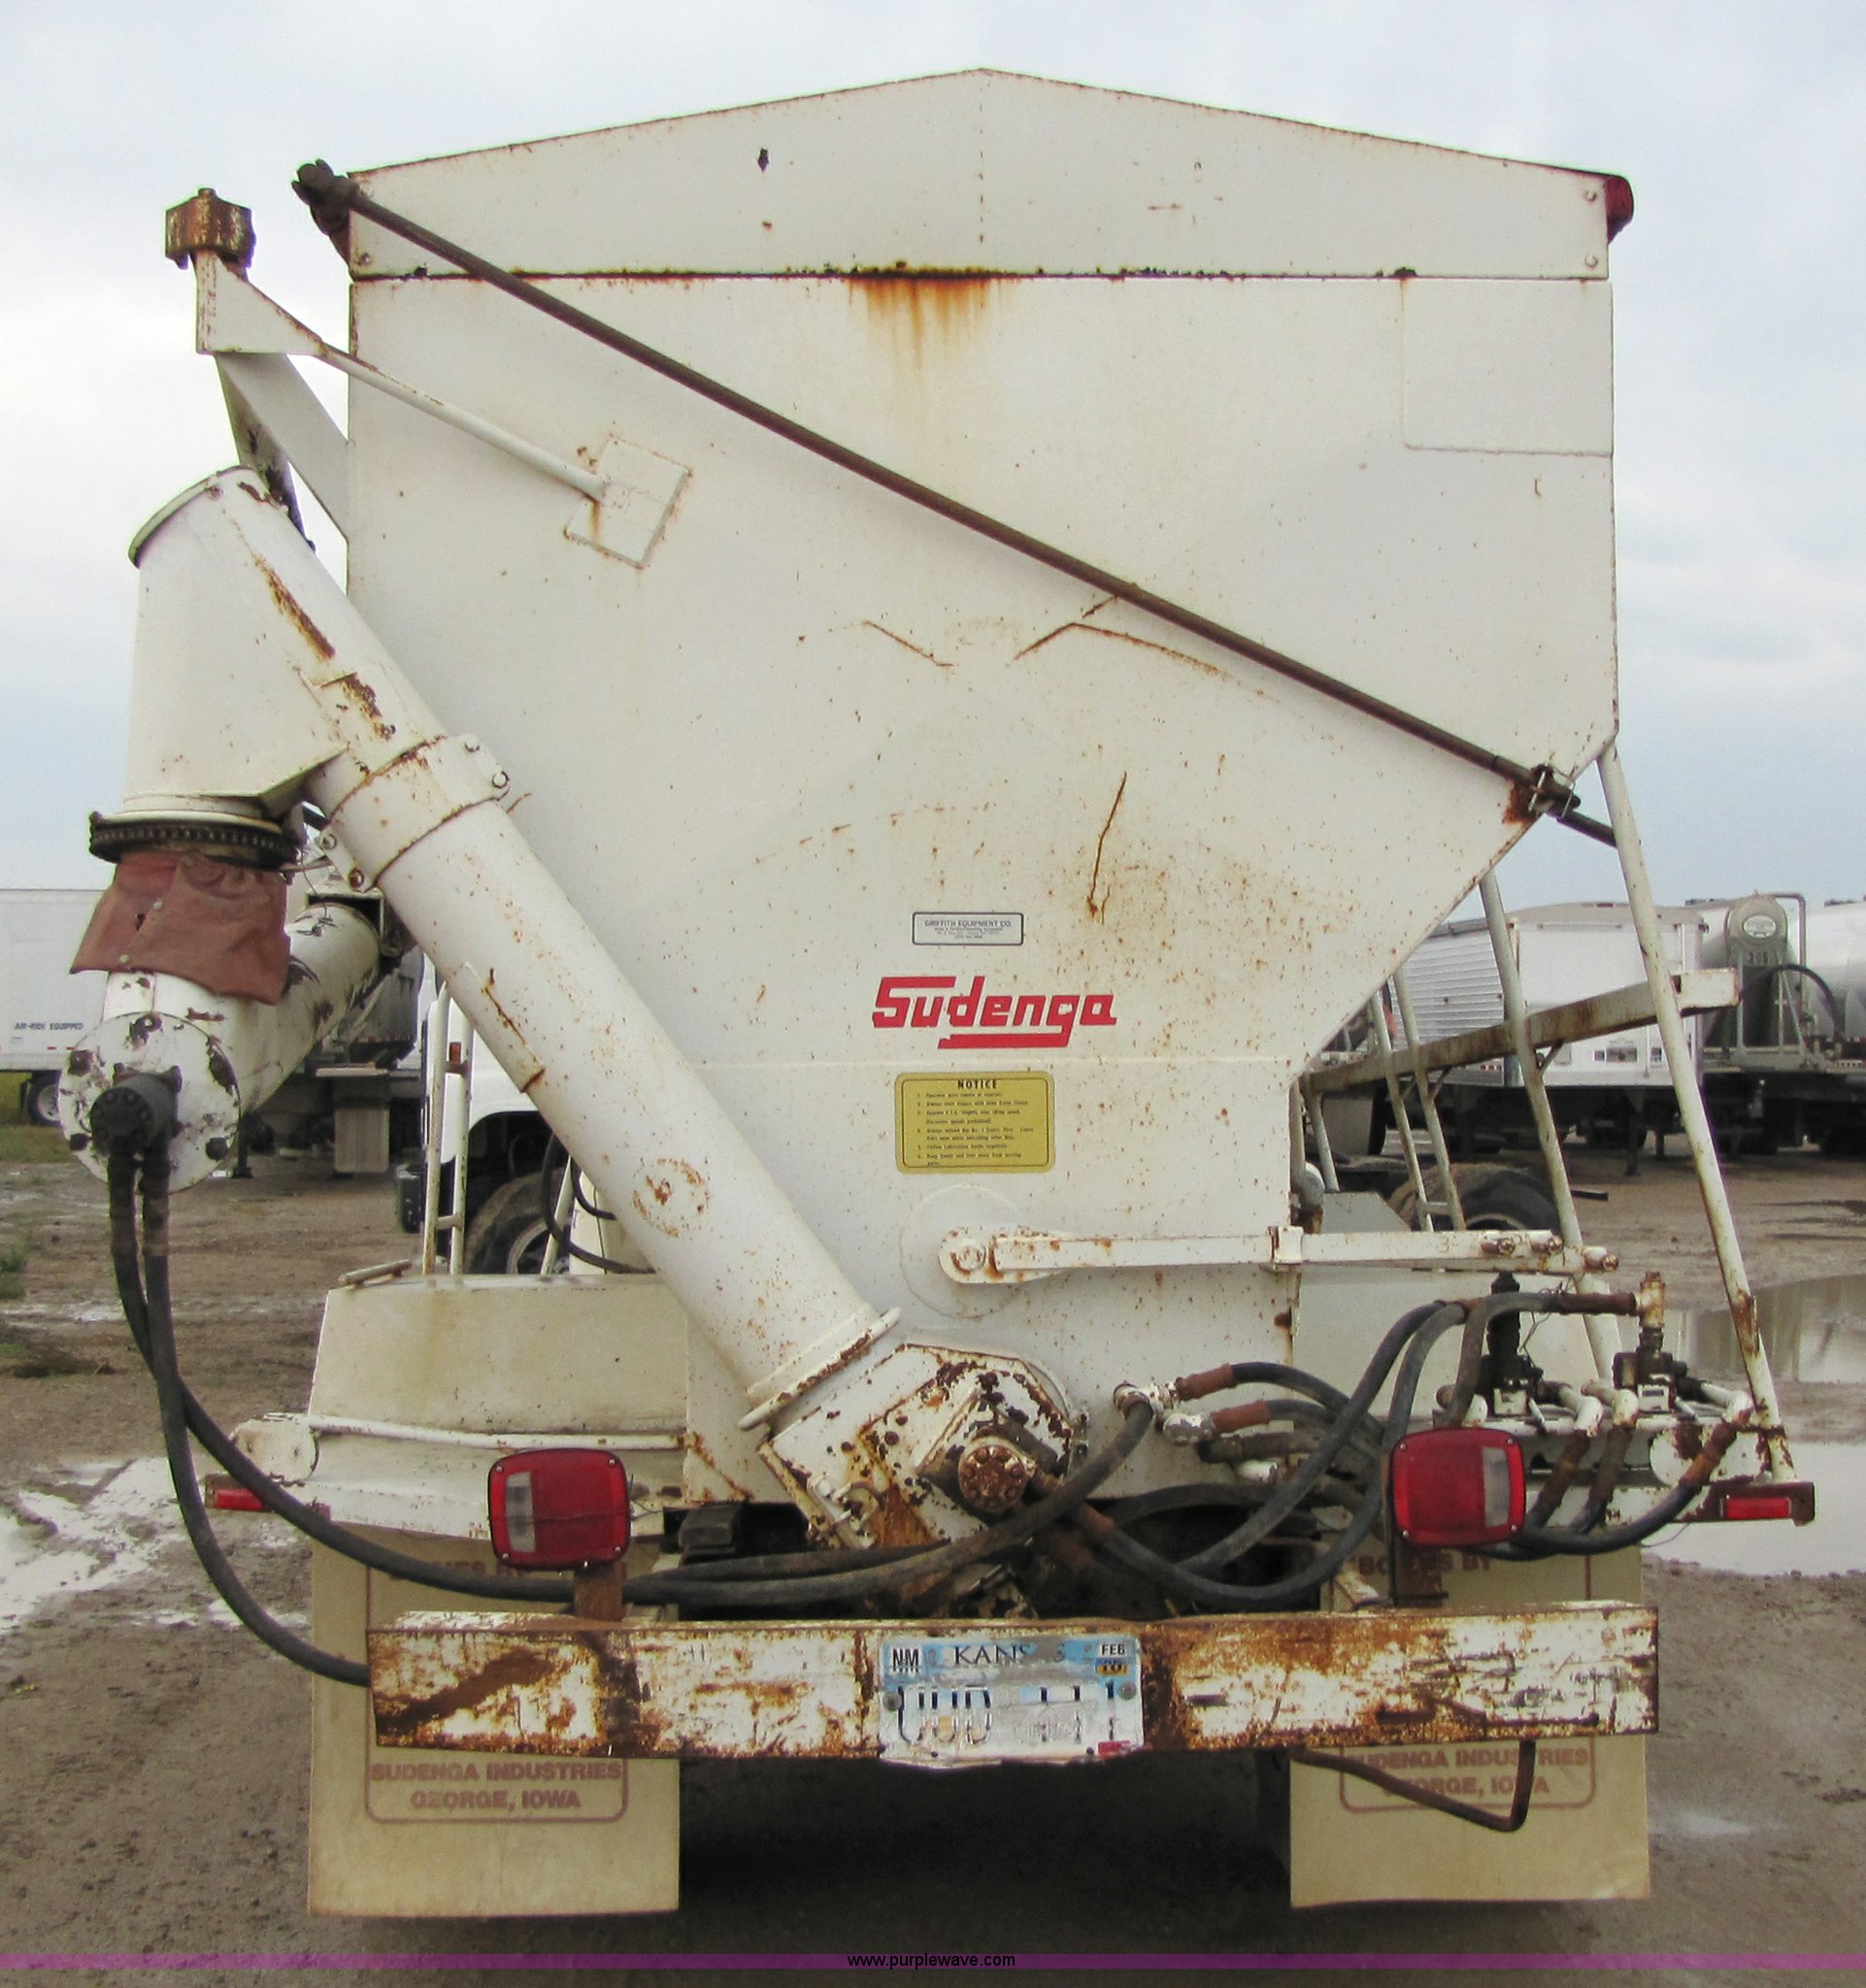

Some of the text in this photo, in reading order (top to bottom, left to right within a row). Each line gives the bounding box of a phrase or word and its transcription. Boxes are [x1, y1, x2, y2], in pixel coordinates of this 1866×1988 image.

[872, 976, 1118, 1049] Sudenga
[957, 1079, 997, 1089] NOTICE
[954, 1644, 1066, 1665] KANSS
[1102, 1643, 1126, 1656] FEB
[371, 1761, 622, 1782] SUDENGA INDUSTRIES
[1491, 1774, 1549, 1795] IOA
[411, 1789, 582, 1811] GEORGE, IOWA
